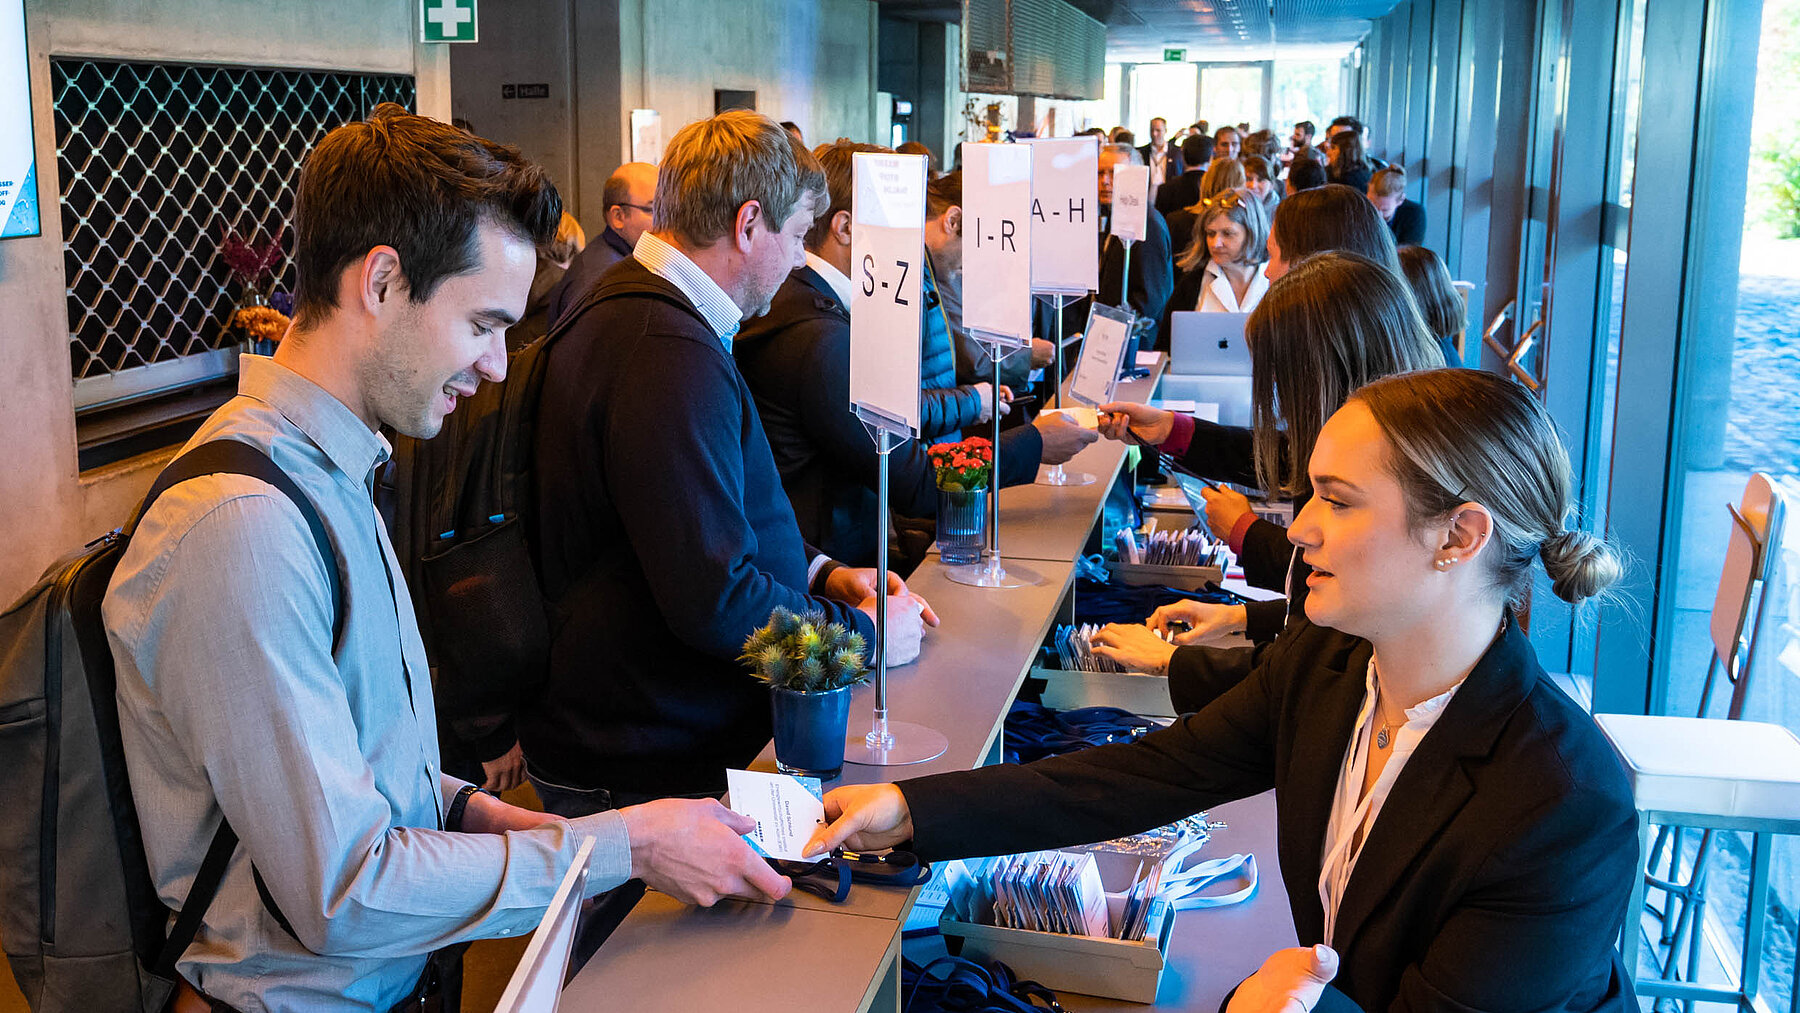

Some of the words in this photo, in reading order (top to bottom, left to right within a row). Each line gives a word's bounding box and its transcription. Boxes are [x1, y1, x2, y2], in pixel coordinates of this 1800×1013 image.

[1031, 198, 1046, 223] A
[1069, 198, 1085, 223] H
[1001, 219, 1016, 253] R
[862, 254, 875, 298] S
[894, 260, 909, 306] Z
